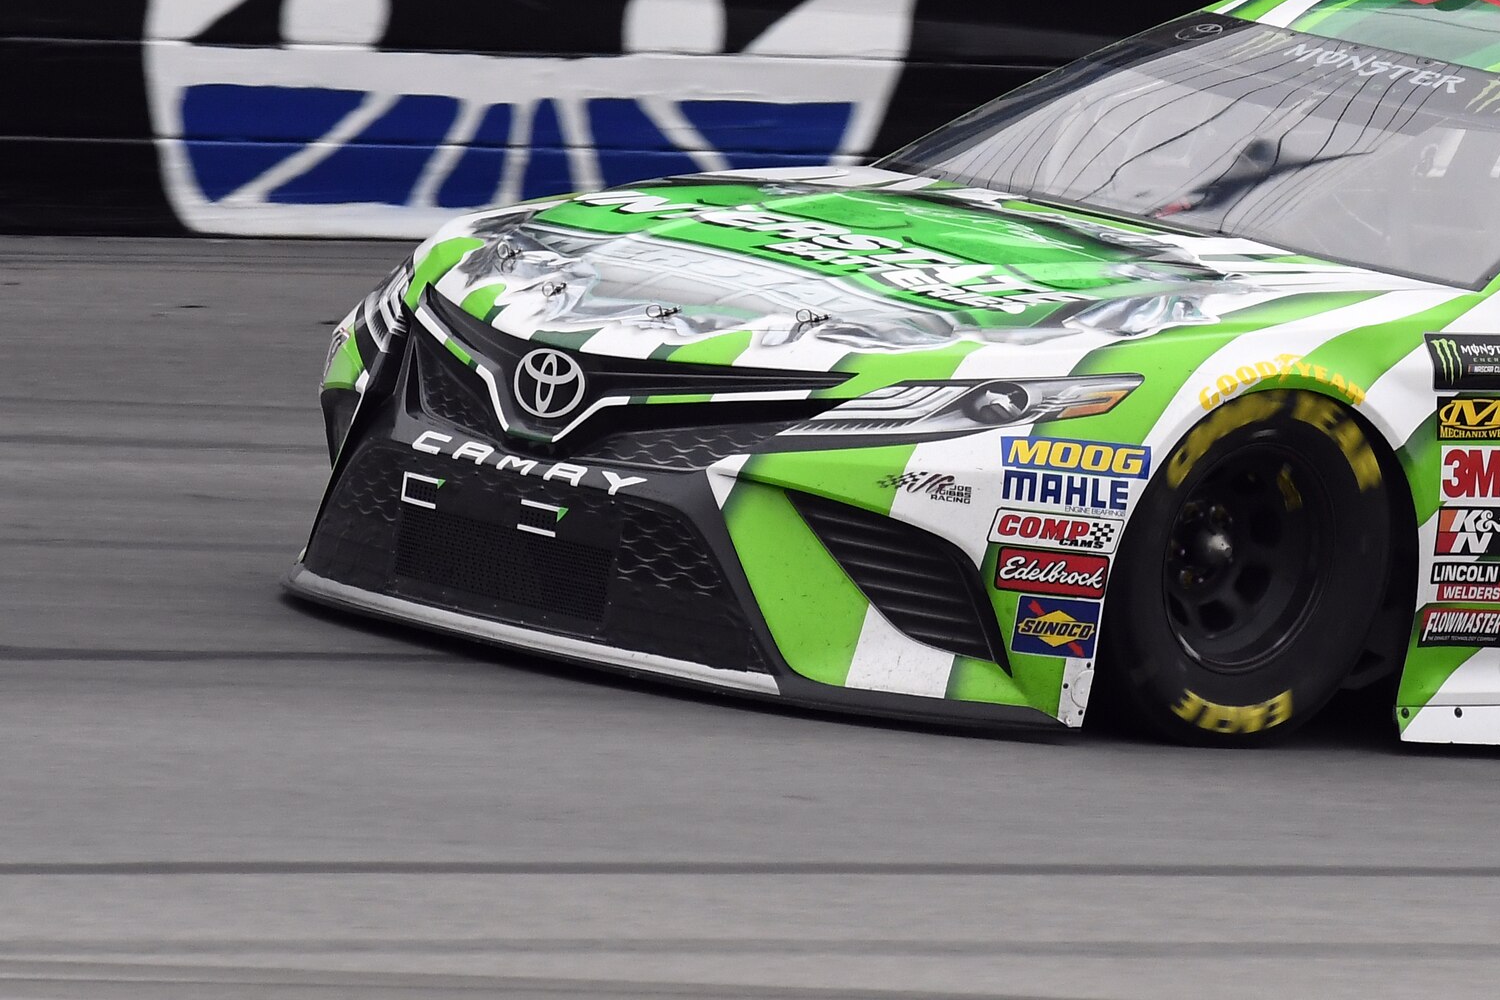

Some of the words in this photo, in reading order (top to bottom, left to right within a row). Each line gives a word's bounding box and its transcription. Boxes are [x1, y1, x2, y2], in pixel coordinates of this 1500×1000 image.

[1440, 426, 1488, 439] MECHANIX
[1008, 439, 1146, 475] MOOG
[950, 484, 972, 493] JOE
[1002, 469, 1129, 511] MAHLE
[930, 494, 971, 505] RACING
[1064, 505, 1091, 515] ENGINE
[997, 514, 1091, 541] COMP
[1058, 537, 1105, 550] CAMS
[999, 555, 1103, 589] Edelbrock
[1433, 564, 1499, 583] LINCOLN
[1443, 586, 1500, 600] WELDERS
[1019, 618, 1092, 640] SUNOCO
